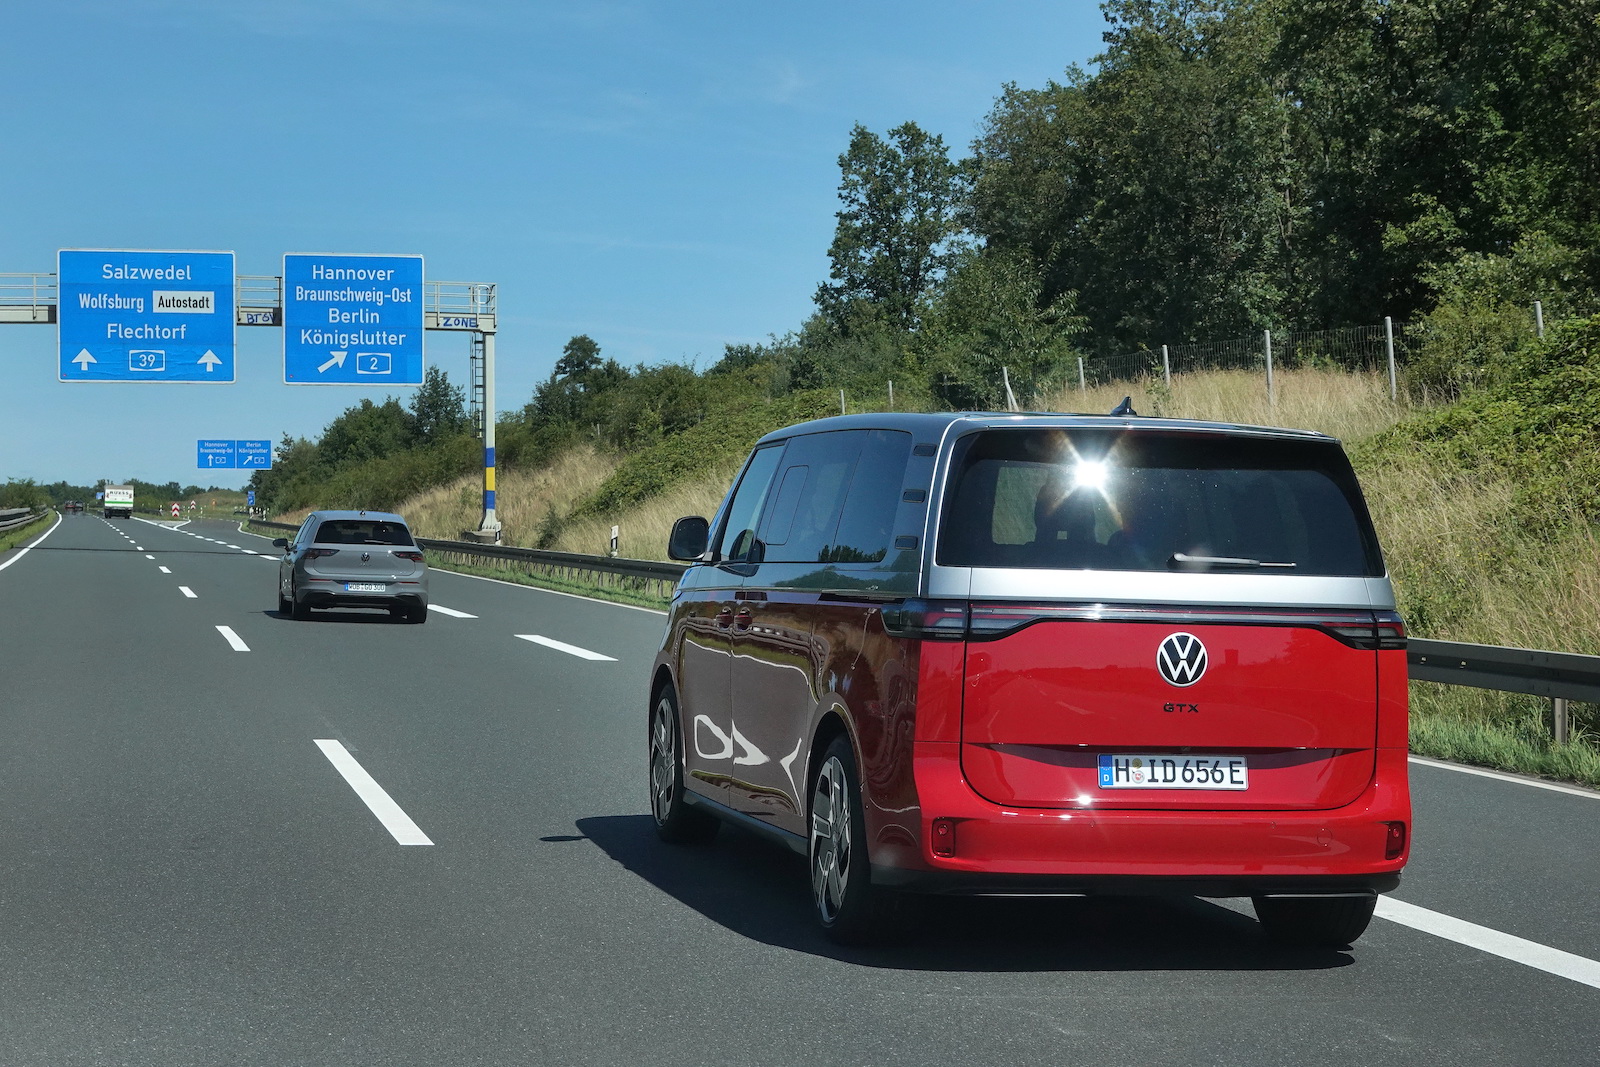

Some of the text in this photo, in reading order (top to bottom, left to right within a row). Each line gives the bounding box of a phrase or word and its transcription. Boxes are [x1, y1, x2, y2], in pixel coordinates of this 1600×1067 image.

[102, 263, 192, 281] Salzwedel
[312, 264, 394, 281] Hannover
[79, 293, 144, 313] Wolfsburg
[158, 295, 210, 309] Autostadt
[295, 285, 412, 306] Braunschweig-Ost
[328, 308, 380, 324] Berlin
[443, 316, 477, 328] ZONE
[107, 323, 187, 340] Flechtorf
[301, 328, 406, 349] Königslutter
[138, 354, 156, 367] 39
[369, 357, 378, 370] 2
[1163, 703, 1199, 713] GTX
